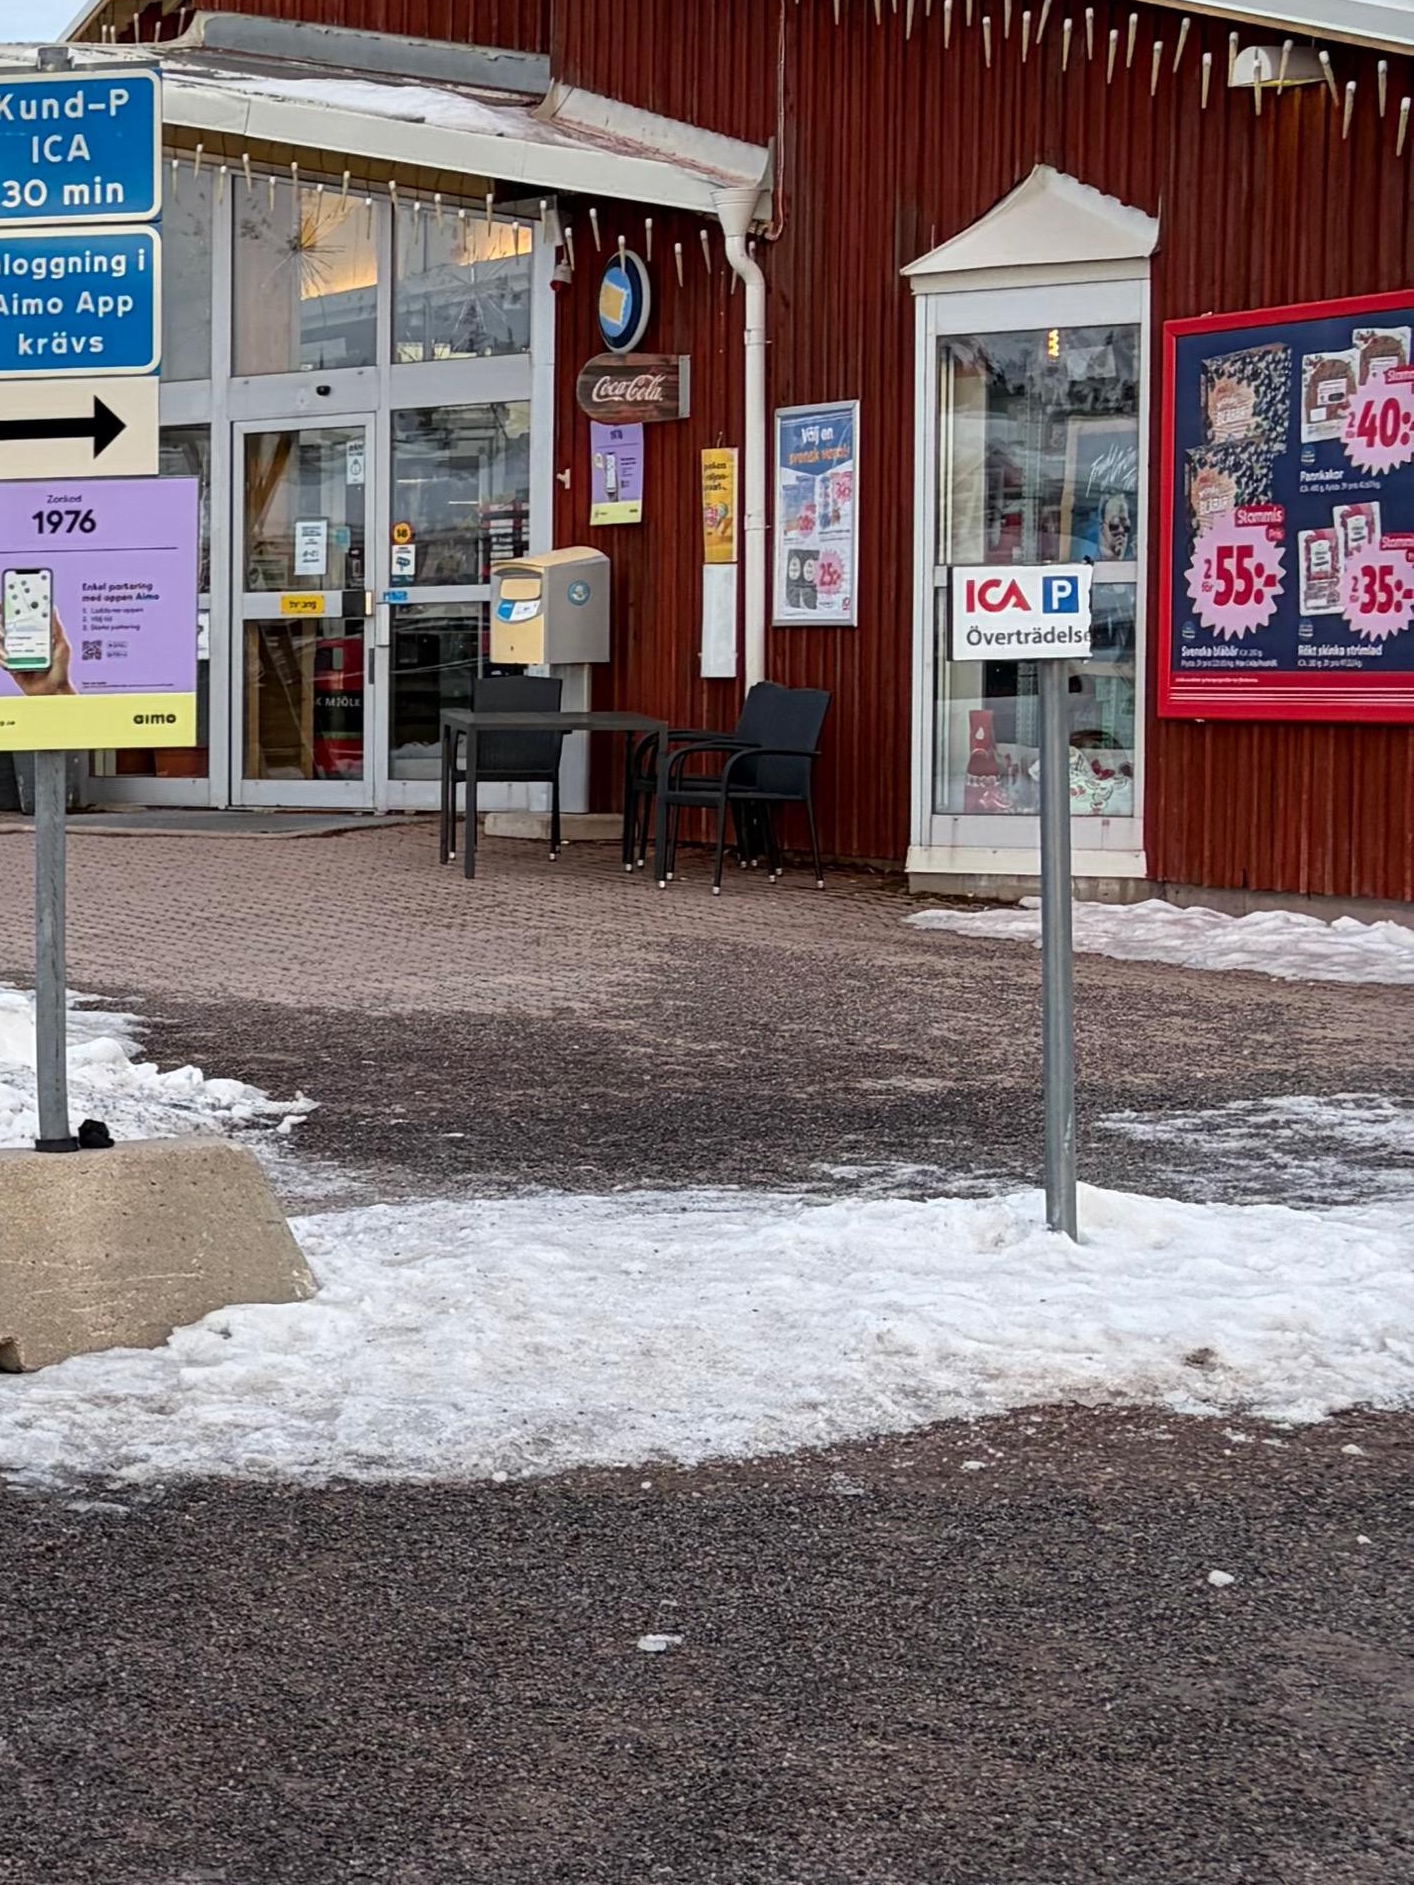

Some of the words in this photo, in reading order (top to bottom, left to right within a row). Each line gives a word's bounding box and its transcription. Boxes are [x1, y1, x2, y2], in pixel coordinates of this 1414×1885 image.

[31, 135, 90, 163] ICA
[1, 179, 47, 208] 30
[62, 177, 124, 206] min
[137, 248, 146, 272] i
[75, 290, 134, 318] App
[18, 331, 104, 356] krävs
[1348, 412, 1356, 428] 2
[31, 509, 97, 534] 1976
[1204, 559, 1212, 580] 2
[1213, 545, 1277, 606] 55:-
[966, 578, 1032, 613] ICA
[1052, 580, 1072, 610] P
[1352, 576, 1358, 593] 2
[133, 713, 176, 725] aimo
